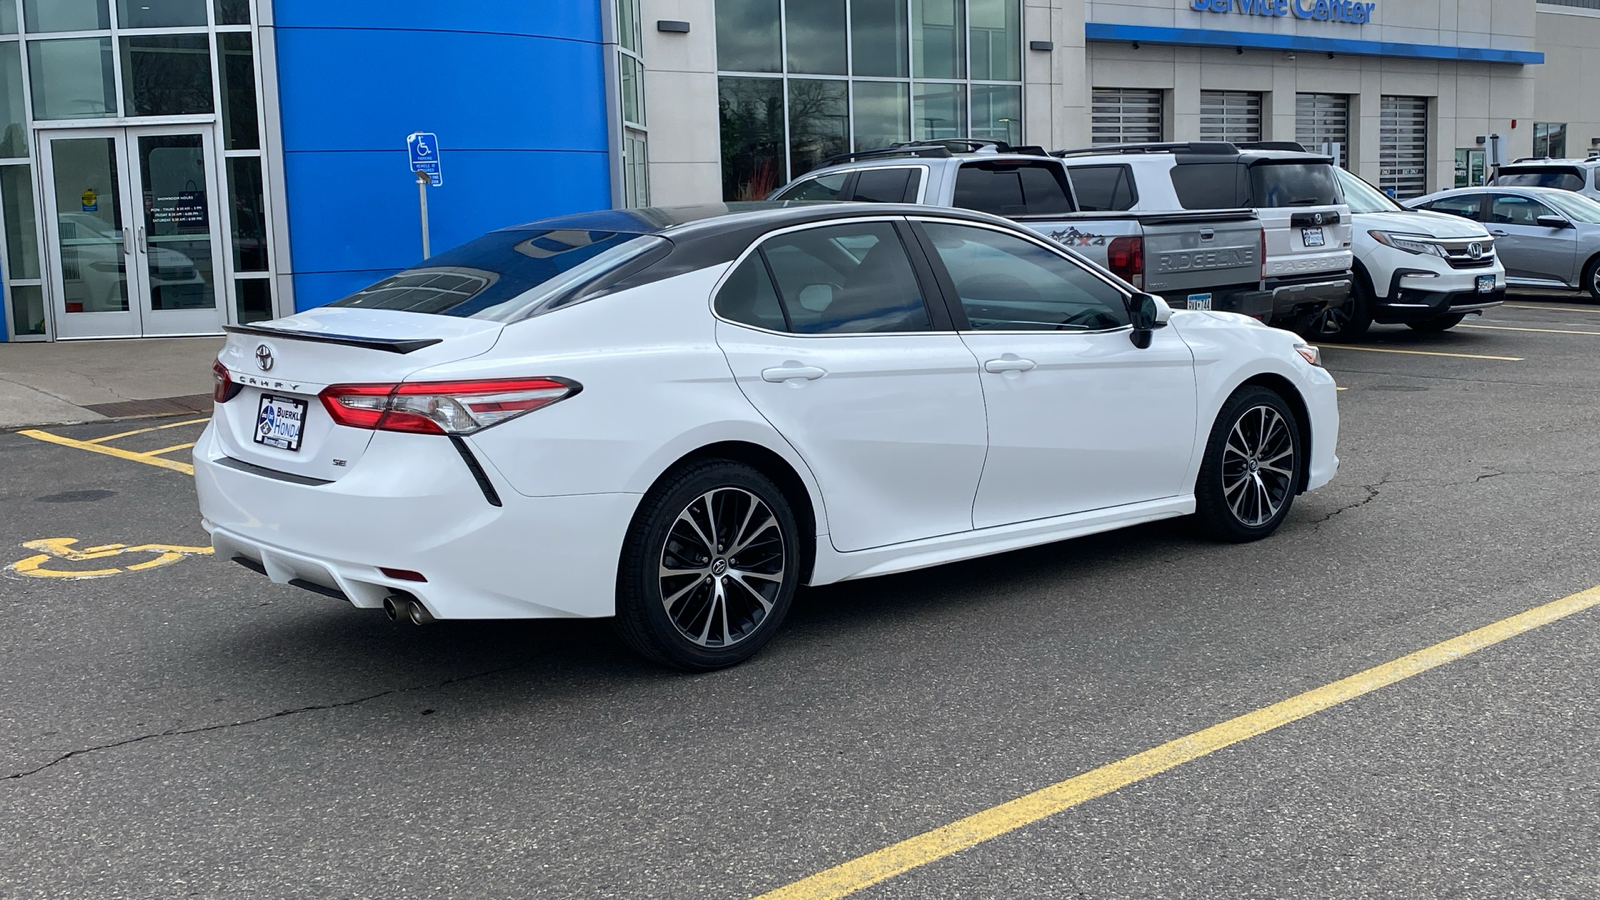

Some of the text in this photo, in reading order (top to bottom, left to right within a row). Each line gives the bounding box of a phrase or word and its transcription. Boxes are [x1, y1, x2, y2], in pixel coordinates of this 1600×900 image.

[1291, 0, 1376, 24] Center
[1158, 250, 1254, 271] RIDGELINE
[1272, 256, 1351, 273] PASSPORT
[239, 375, 300, 391] CAMRY
[276, 406, 301, 422] BUERKL
[273, 418, 300, 438] HONDA
[332, 458, 347, 467] SE
